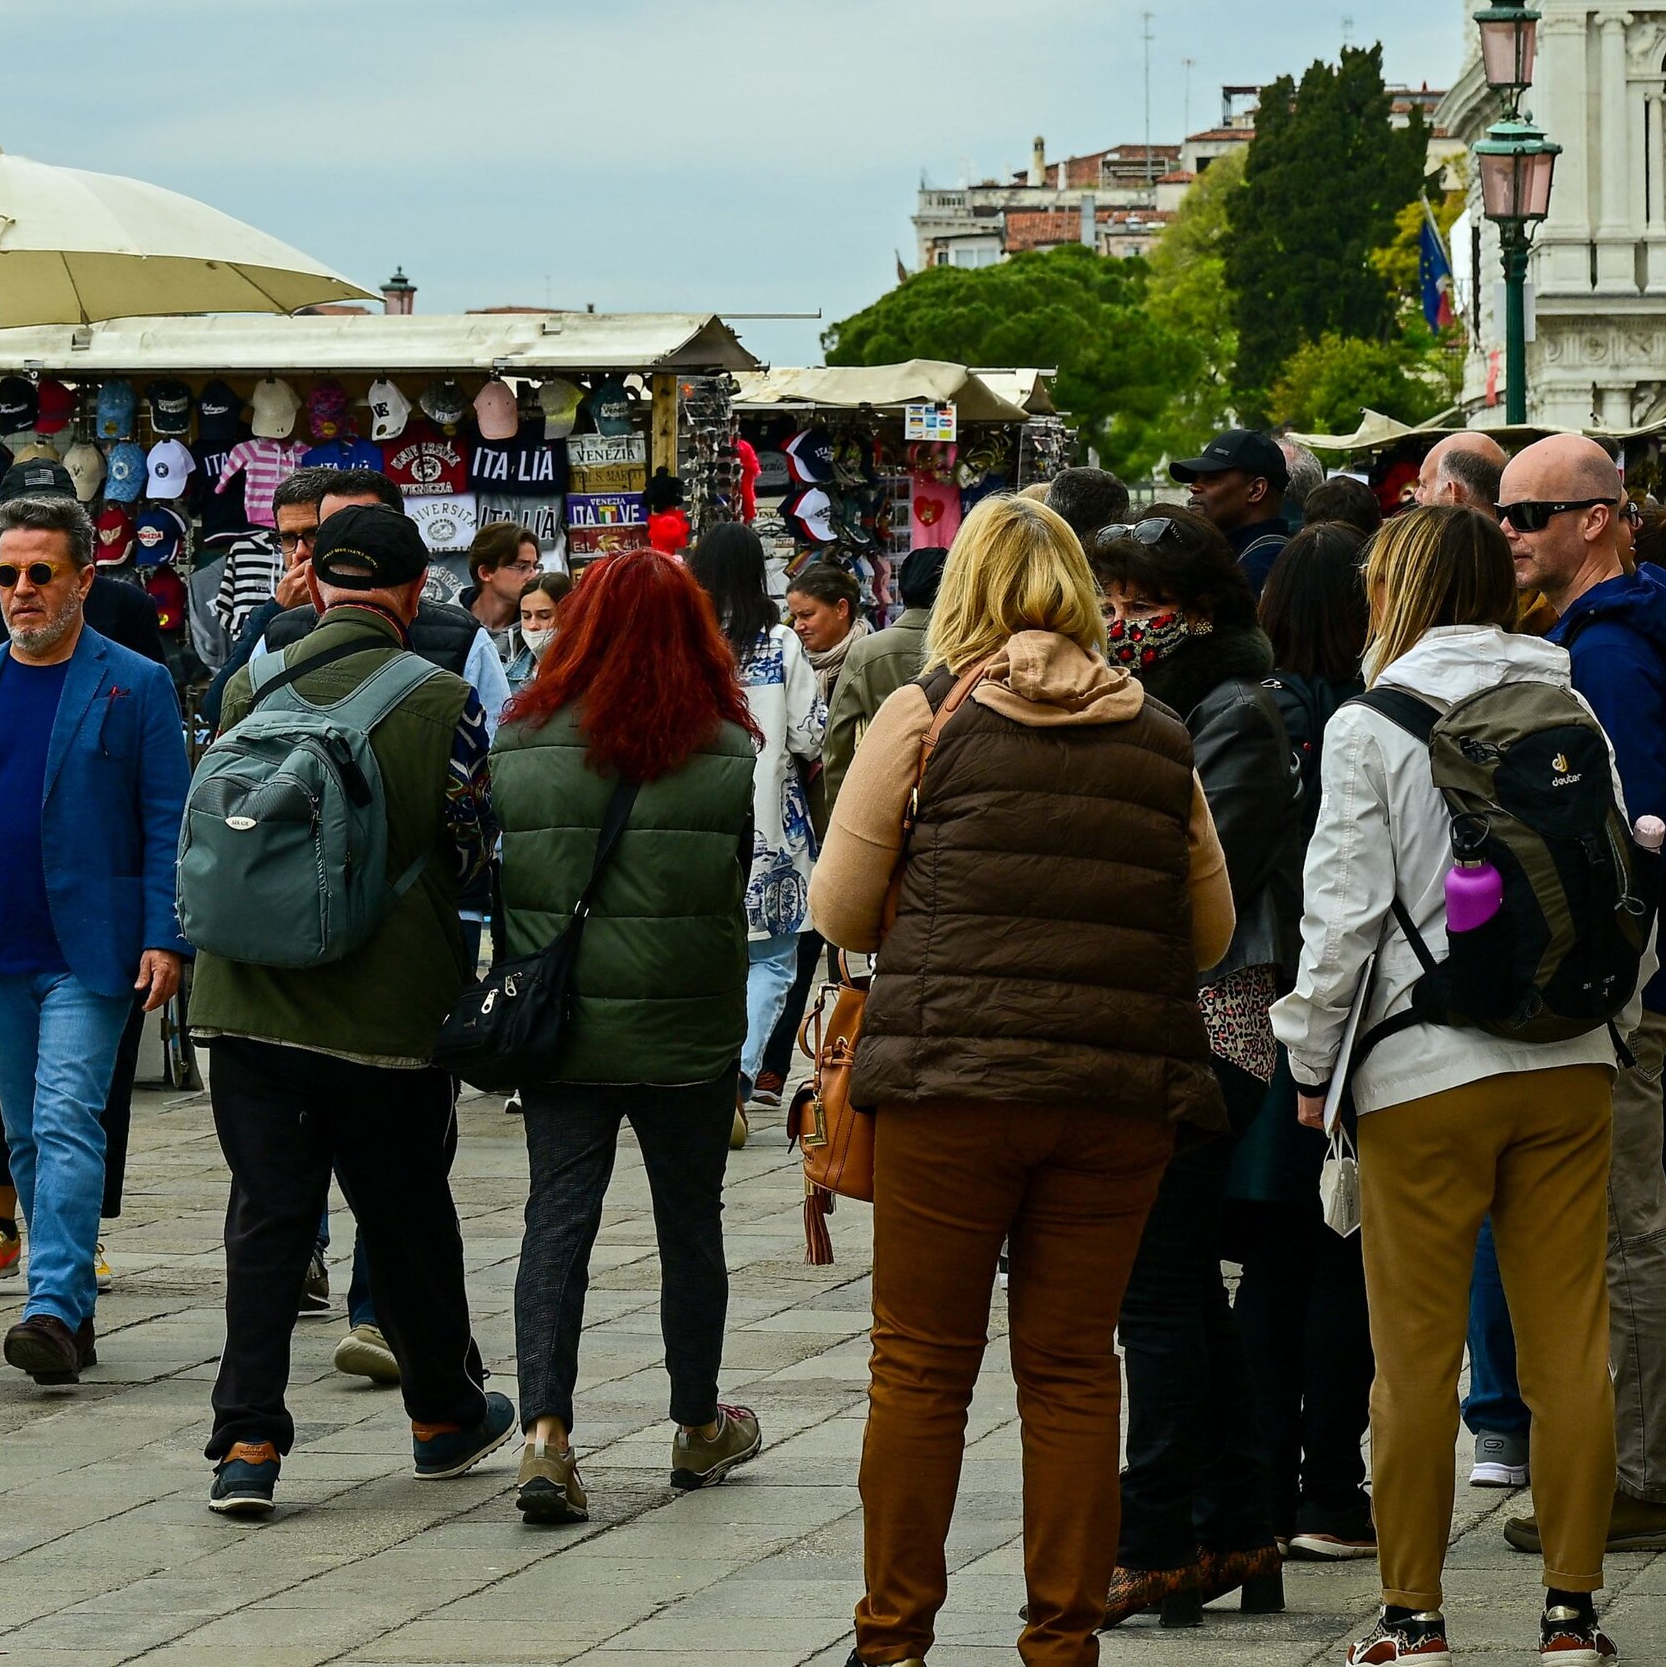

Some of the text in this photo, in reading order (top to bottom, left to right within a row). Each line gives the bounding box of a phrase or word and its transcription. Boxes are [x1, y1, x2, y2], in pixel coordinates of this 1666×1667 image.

[576, 449, 635, 462] VENEZIA
[400, 482, 453, 494] VENEZIA
[590, 498, 626, 506] VENEZIA
[412, 502, 477, 528] NIVERSITA
[1552, 773, 1582, 787] deuter
